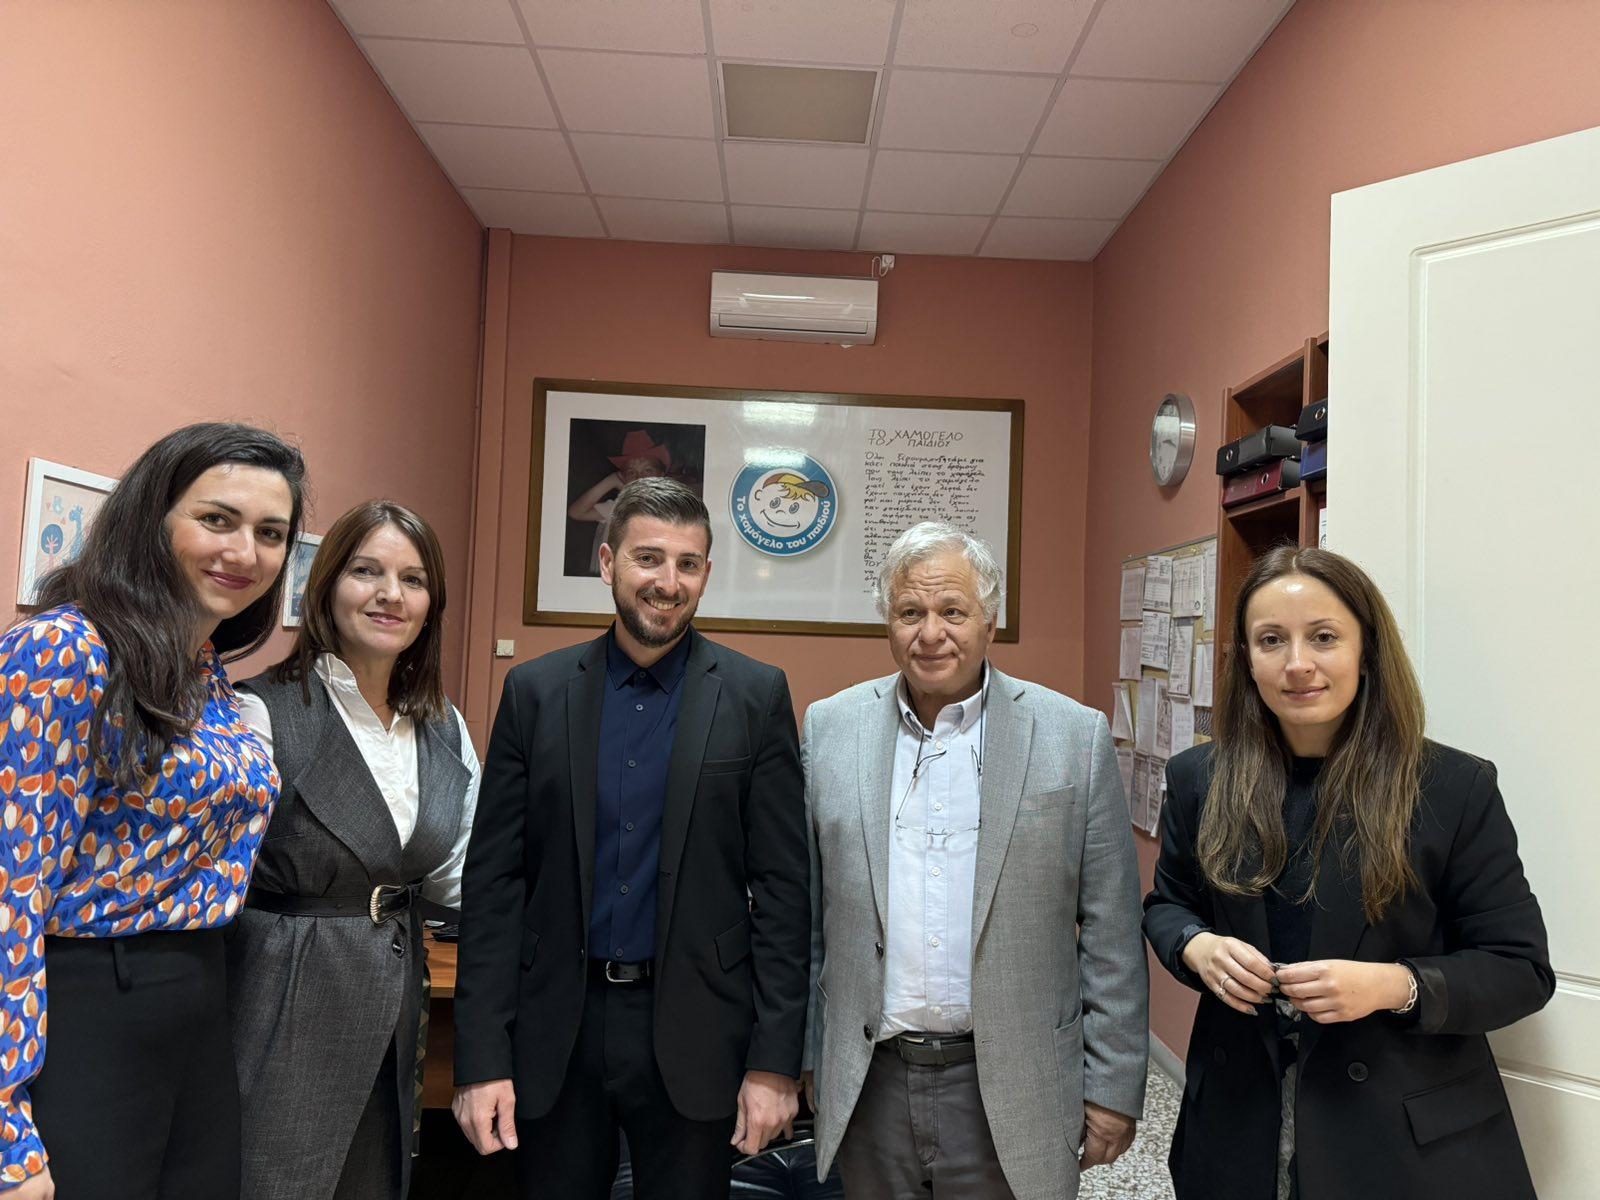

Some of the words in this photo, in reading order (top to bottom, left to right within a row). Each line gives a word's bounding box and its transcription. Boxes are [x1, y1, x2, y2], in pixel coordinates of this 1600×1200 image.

[869, 429, 887, 439] ΤΟ
[894, 429, 964, 441] ΧΑΜΟΓΕΛΟ
[868, 437, 894, 446] ΤΟΥ
[907, 439, 951, 448] ΠΑΙΔΙΟΥ
[737, 496, 746, 511] Το
[806, 500, 831, 541] παιδιού
[739, 514, 783, 549] χαμόγελο
[786, 537, 807, 549] του
